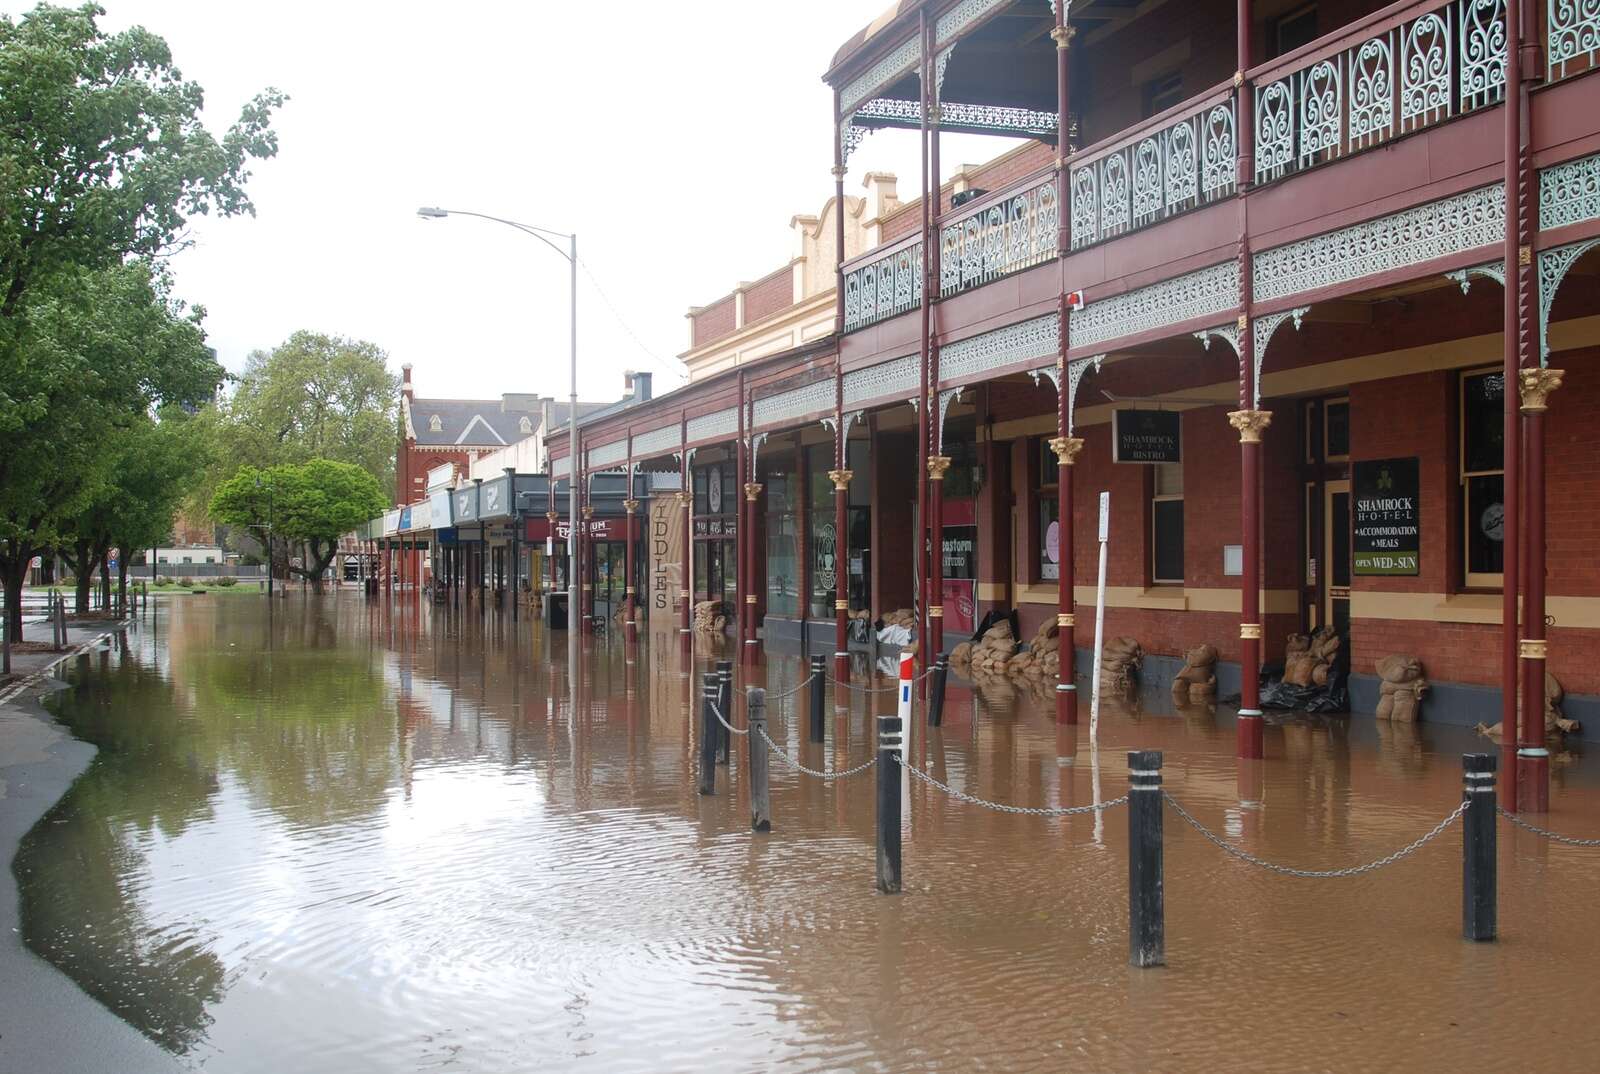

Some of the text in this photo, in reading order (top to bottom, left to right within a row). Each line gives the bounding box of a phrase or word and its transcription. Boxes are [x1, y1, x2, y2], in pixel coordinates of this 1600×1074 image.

[1122, 434, 1174, 444] SHAMROCK
[1132, 450, 1166, 460] BISTRO
[1357, 498, 1412, 512] SHAMROCK
[1358, 526, 1417, 536] ACCOMMODATION
[1375, 538, 1399, 548] MEALS
[1355, 559, 1371, 567] OPEN
